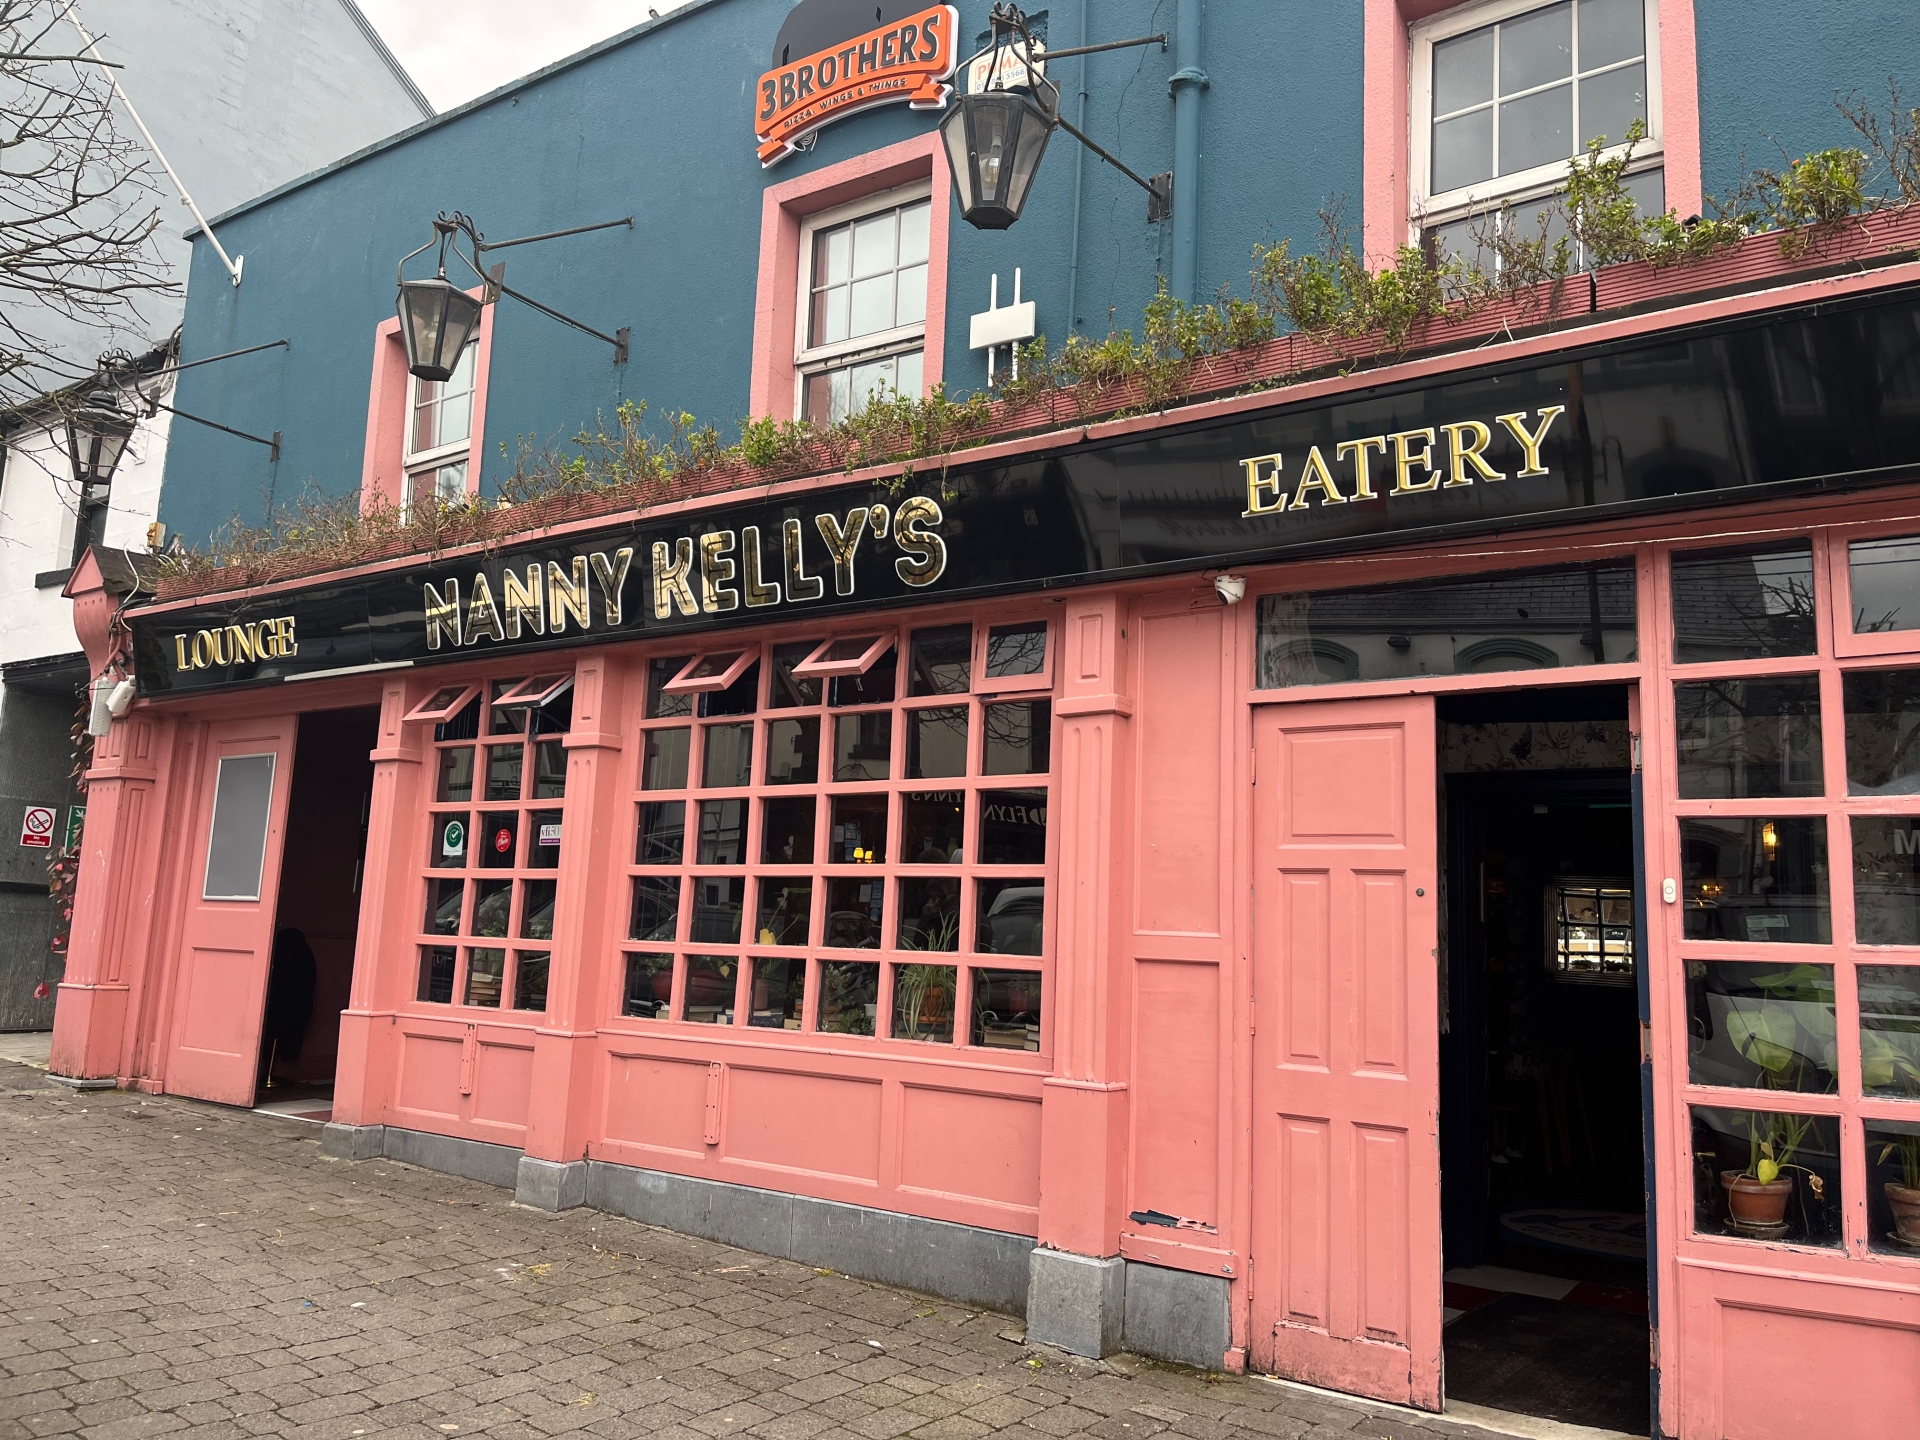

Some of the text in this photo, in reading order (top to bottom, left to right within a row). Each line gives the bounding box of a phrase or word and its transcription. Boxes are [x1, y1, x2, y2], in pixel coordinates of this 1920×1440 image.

[820, 90, 854, 110] WINGS
[857, 87, 865, 96] &
[868, 77, 907, 92] THINGS
[1239, 405, 1565, 518] EATERY
[423, 496, 948, 650] NANNY KELLY'S
[174, 615, 299, 672] LOUNGE
